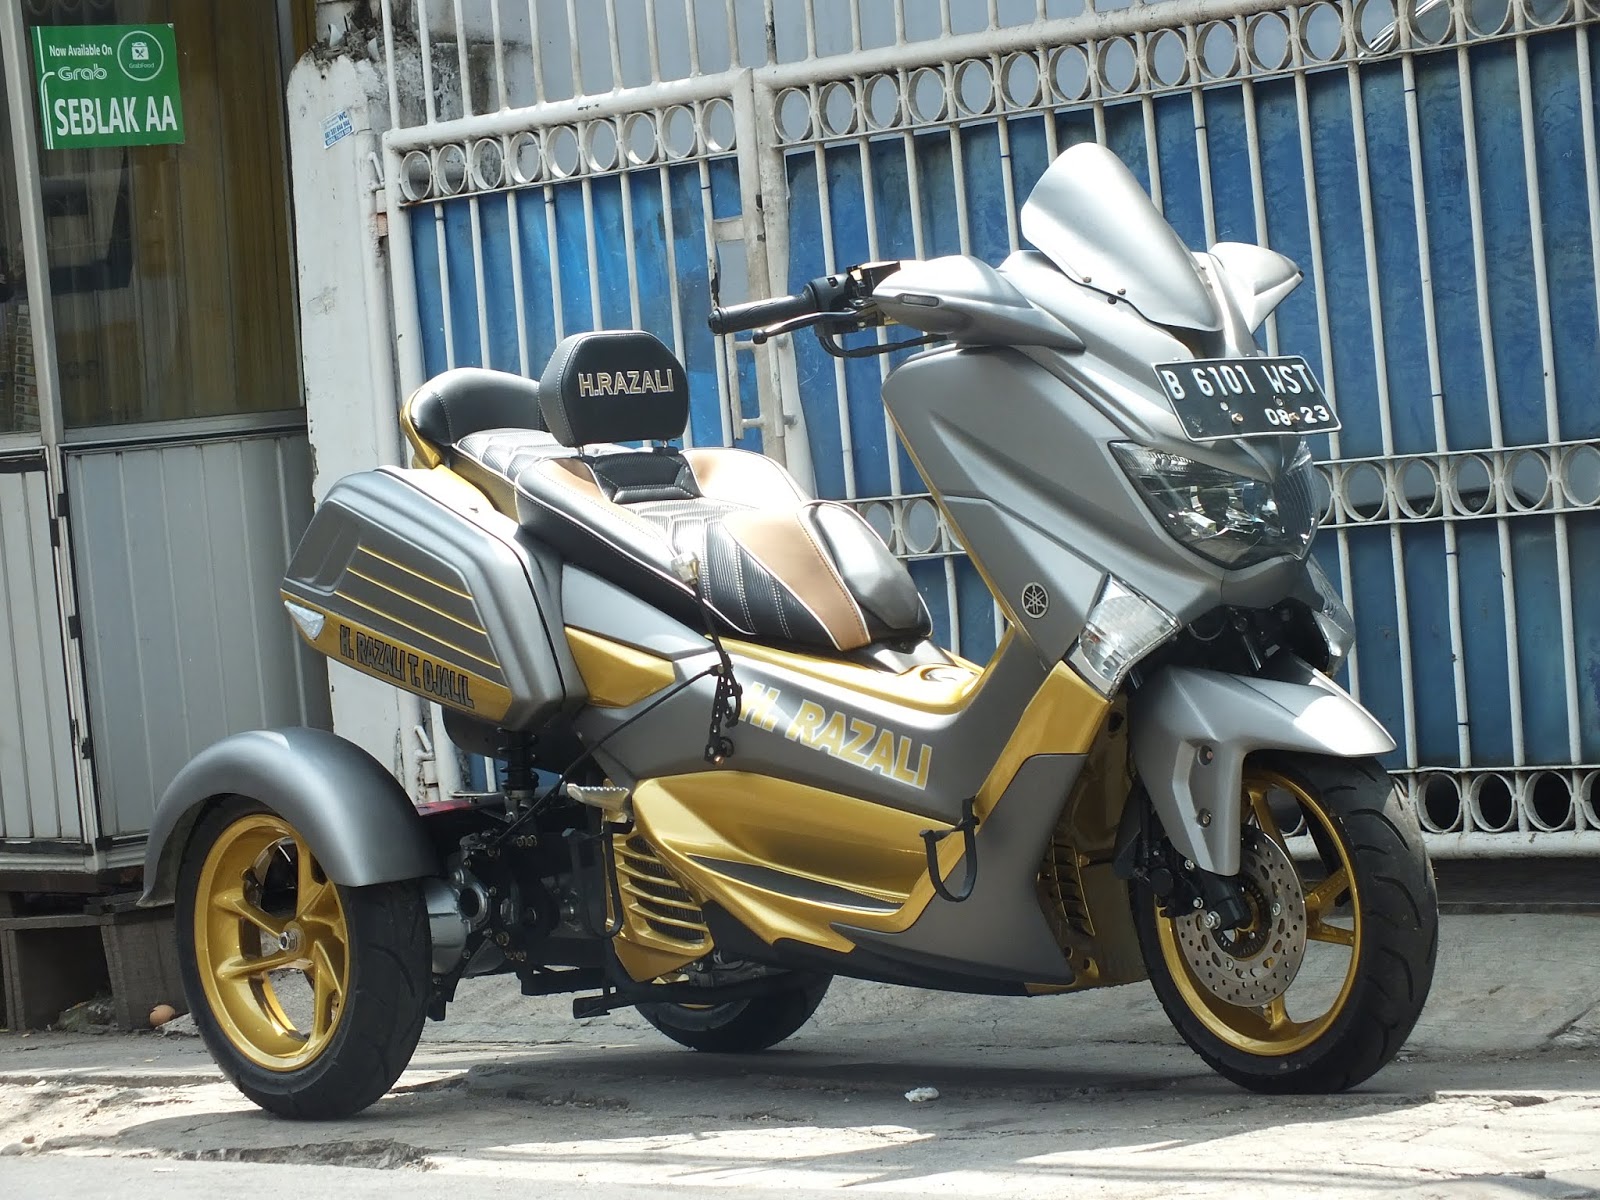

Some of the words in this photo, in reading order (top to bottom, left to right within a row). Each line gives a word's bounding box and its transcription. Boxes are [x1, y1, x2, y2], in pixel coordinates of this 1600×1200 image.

[49, 45, 67, 57] Now
[68, 44, 101, 56] Available
[102, 44, 113, 56] On
[58, 63, 108, 81] Grab
[54, 98, 141, 136] SEBLAK
[145, 95, 178, 132] AA
[578, 368, 675, 398] H.RAZALI
[1160, 370, 1186, 401] B
[1191, 365, 1257, 397] 6101
[1260, 364, 1316, 395] WST
[339, 624, 355, 661] H.
[356, 631, 406, 682] RAZALI
[422, 659, 475, 709] DJALIL
[784, 698, 933, 791] RAZALI
